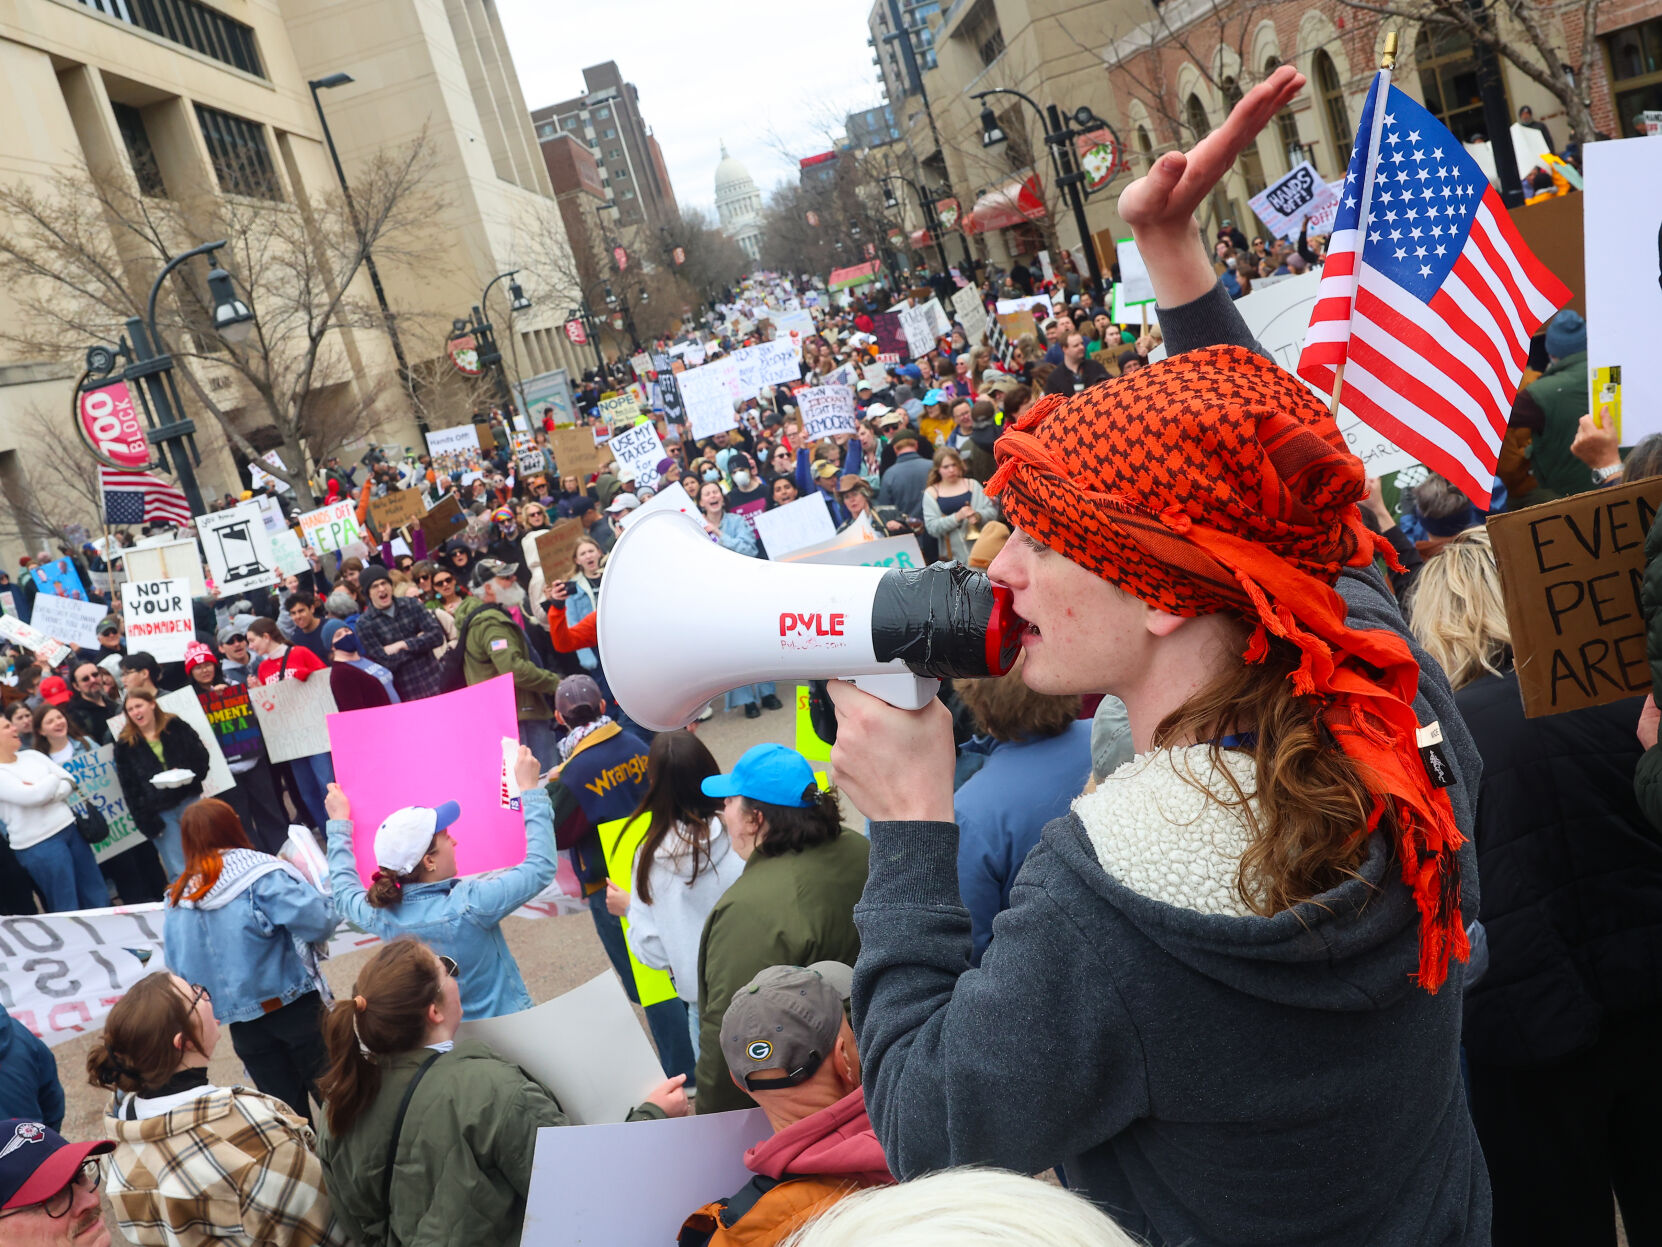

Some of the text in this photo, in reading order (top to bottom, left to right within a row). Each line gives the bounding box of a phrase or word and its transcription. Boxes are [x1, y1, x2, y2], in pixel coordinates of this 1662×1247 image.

[1268, 170, 1311, 208] HANDS
[600, 394, 635, 411] NOPE
[85, 392, 130, 457] 700
[115, 398, 146, 453] BLOCK
[805, 415, 856, 436] DEMOCRAC
[612, 432, 635, 452] USE
[635, 424, 651, 440] MY
[619, 437, 657, 463] TAXES
[301, 504, 351, 530] HANDS OFF
[315, 518, 358, 552] EPA
[137, 581, 174, 597] NOT
[130, 596, 183, 616] YOUR
[128, 618, 192, 637] HANDMAIDEN
[779, 613, 844, 636] PYLE
[206, 704, 253, 724] OMENT.
[220, 717, 248, 734] IS A
[62, 751, 100, 774] ONLY
